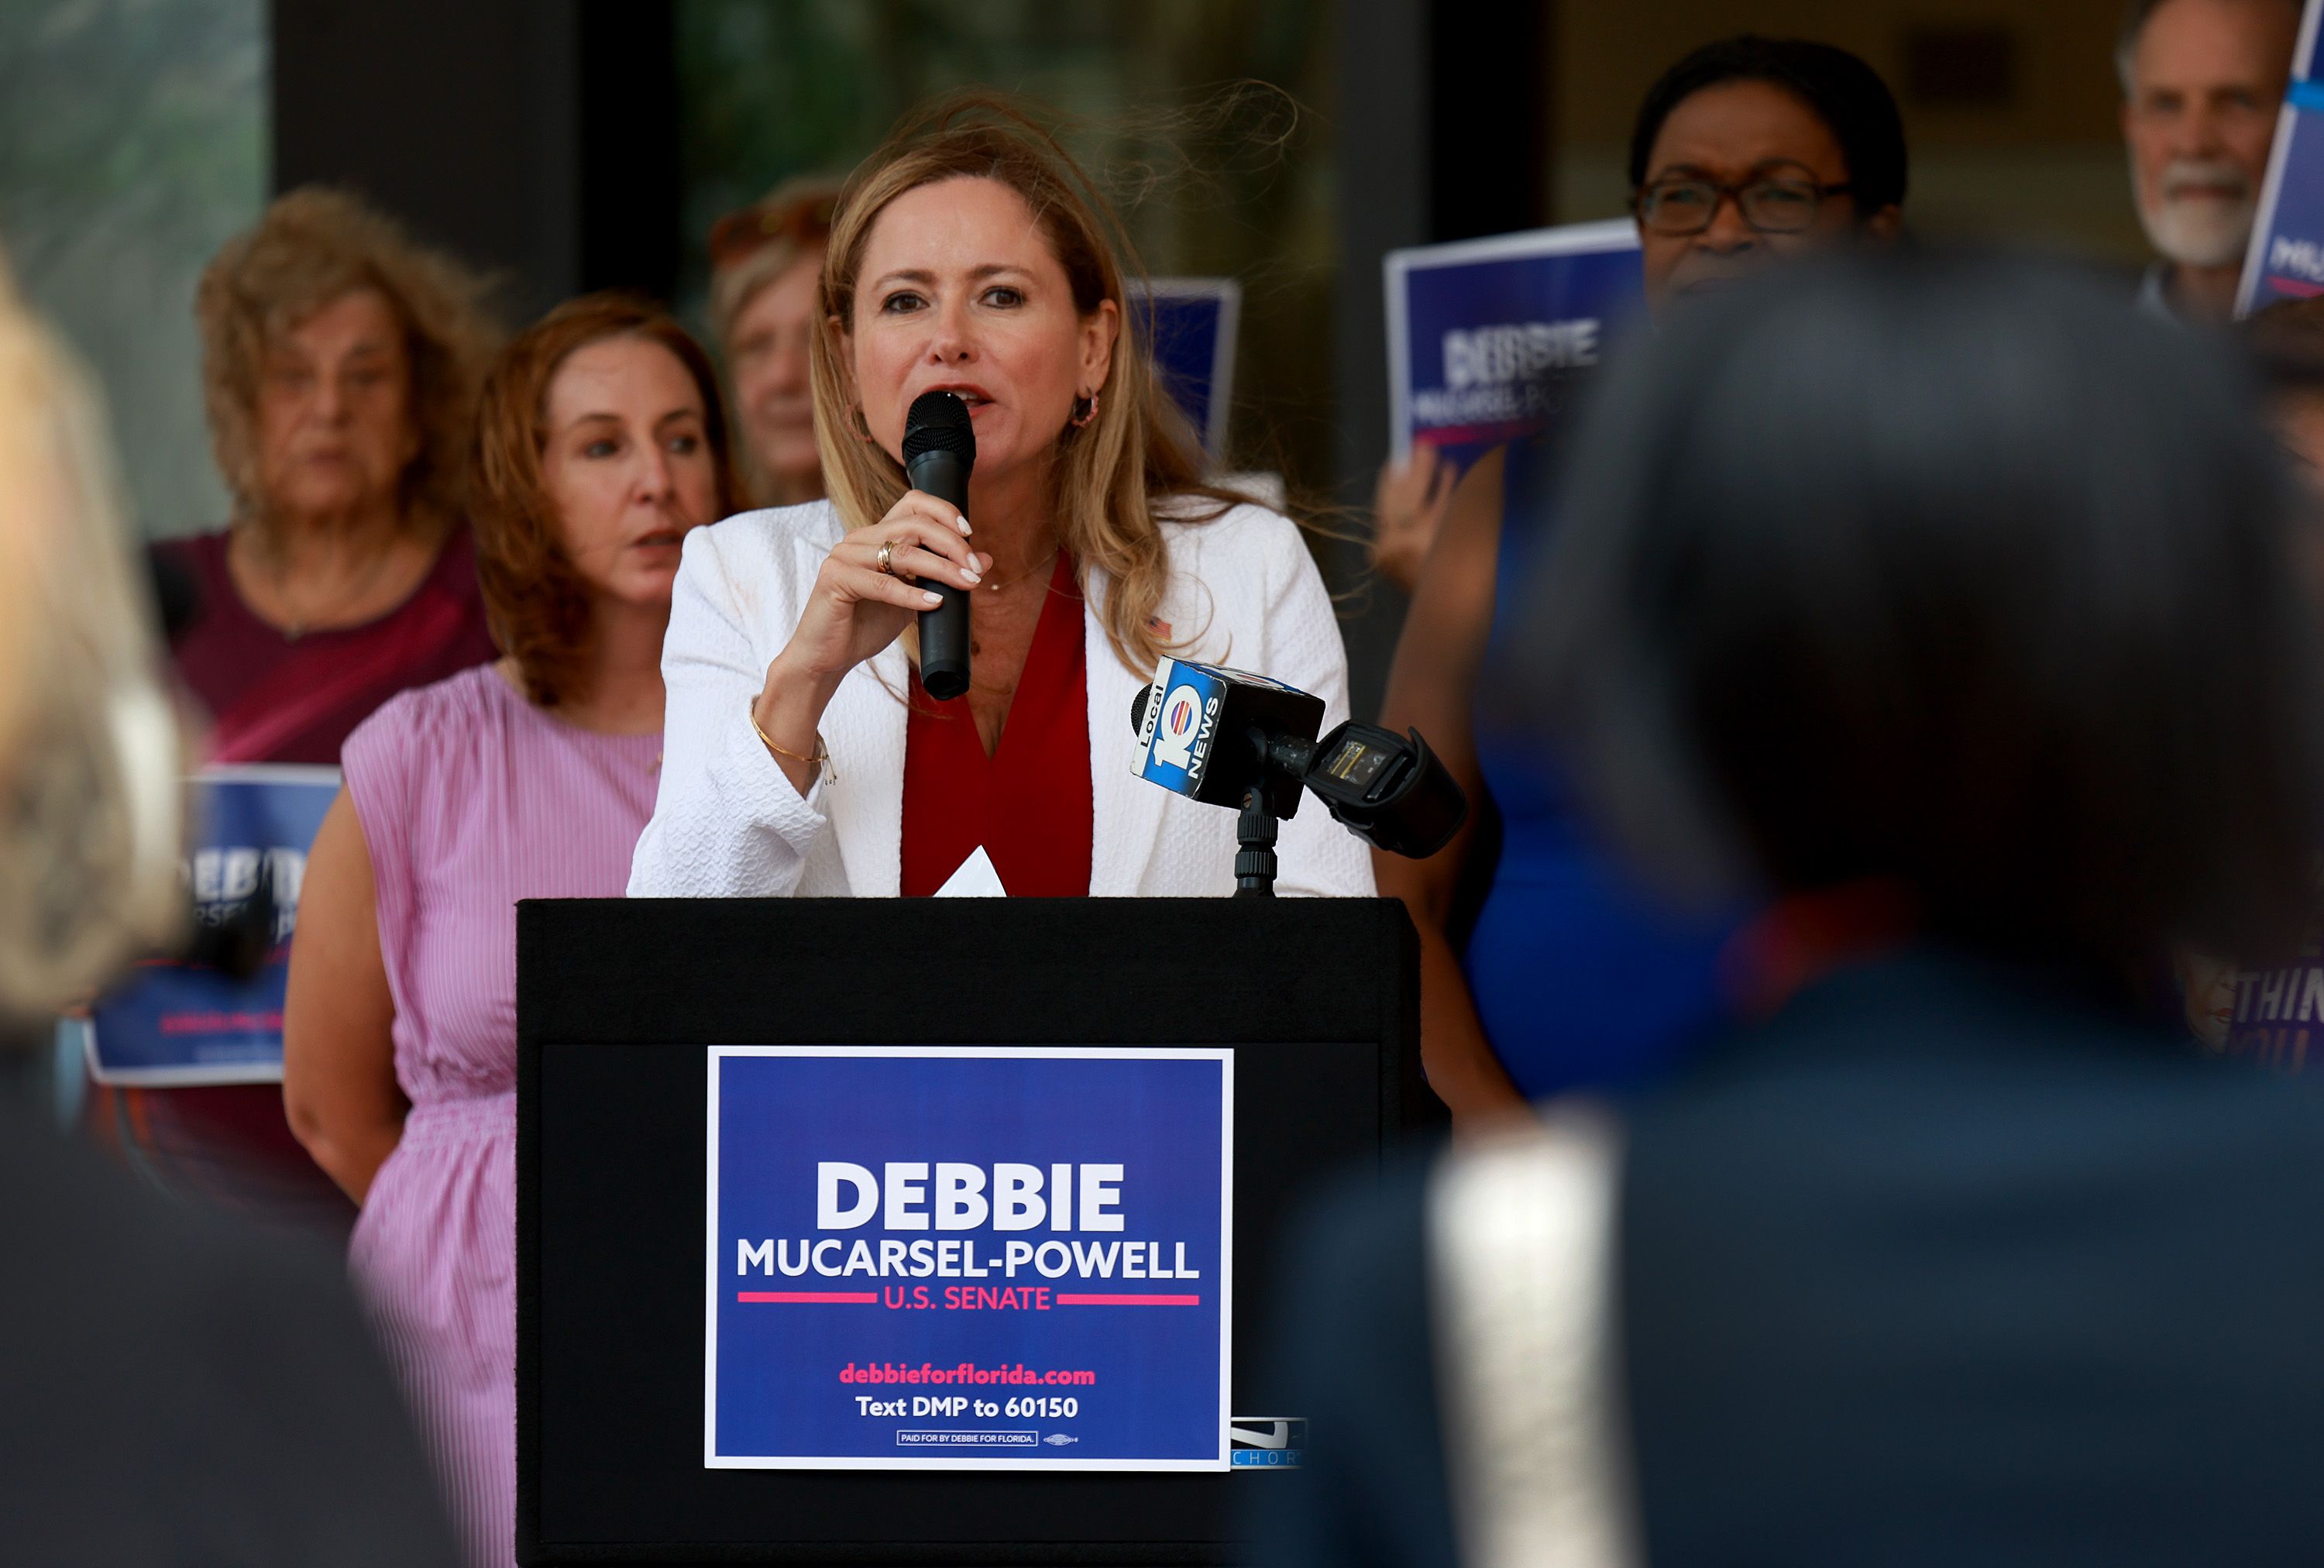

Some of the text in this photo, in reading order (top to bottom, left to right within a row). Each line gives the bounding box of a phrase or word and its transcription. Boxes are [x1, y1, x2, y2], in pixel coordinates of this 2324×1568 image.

[1140, 685, 1164, 748] Local
[1188, 696, 1219, 779] NEWS
[816, 1161, 1125, 1232] DEBBIE
[737, 1238, 1200, 1281] MUCARSEL-POWELL
[883, 1286, 1051, 1311] U.S. SENATE
[839, 1363, 1096, 1387] debbieforflorida.com
[855, 1395, 1079, 1419] Text DMP to 60150
[951, 1435, 978, 1443] DEBBIE
[980, 1435, 997, 1443] FOR
